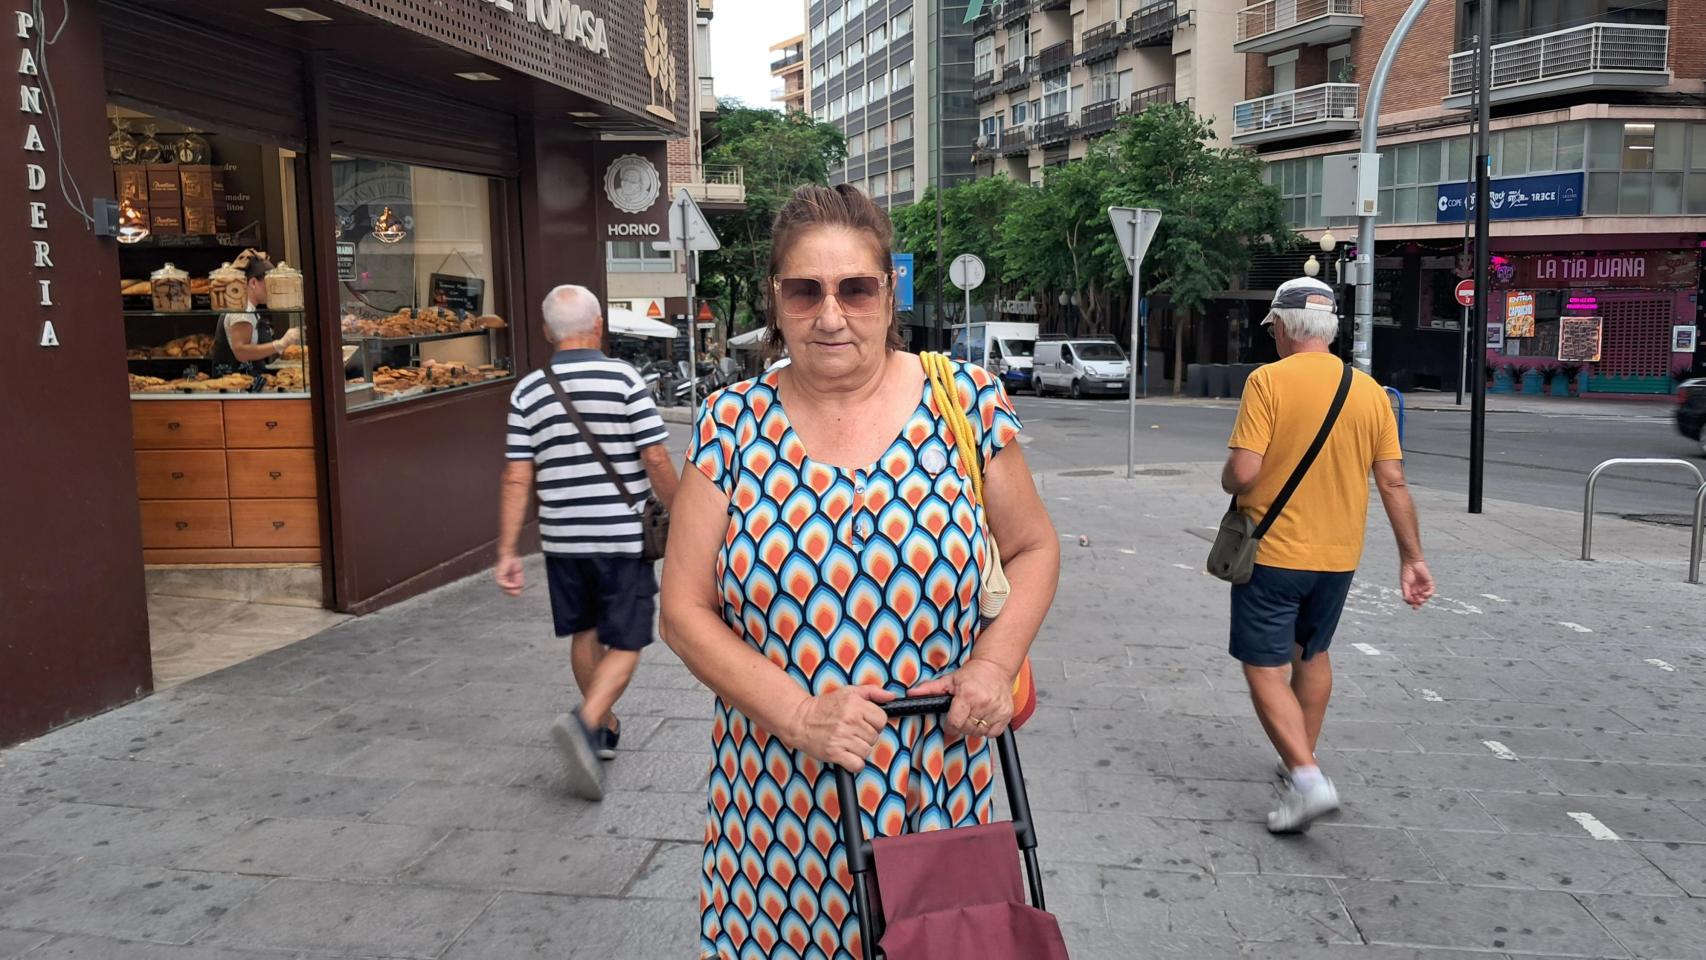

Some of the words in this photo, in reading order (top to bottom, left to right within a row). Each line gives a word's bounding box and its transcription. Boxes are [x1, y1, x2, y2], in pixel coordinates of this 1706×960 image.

[15, 10, 60, 347] PANADERIA
[607, 223, 660, 236] HORNO
[1537, 259, 1557, 279] LA
[1590, 257, 1646, 279] JUANA
